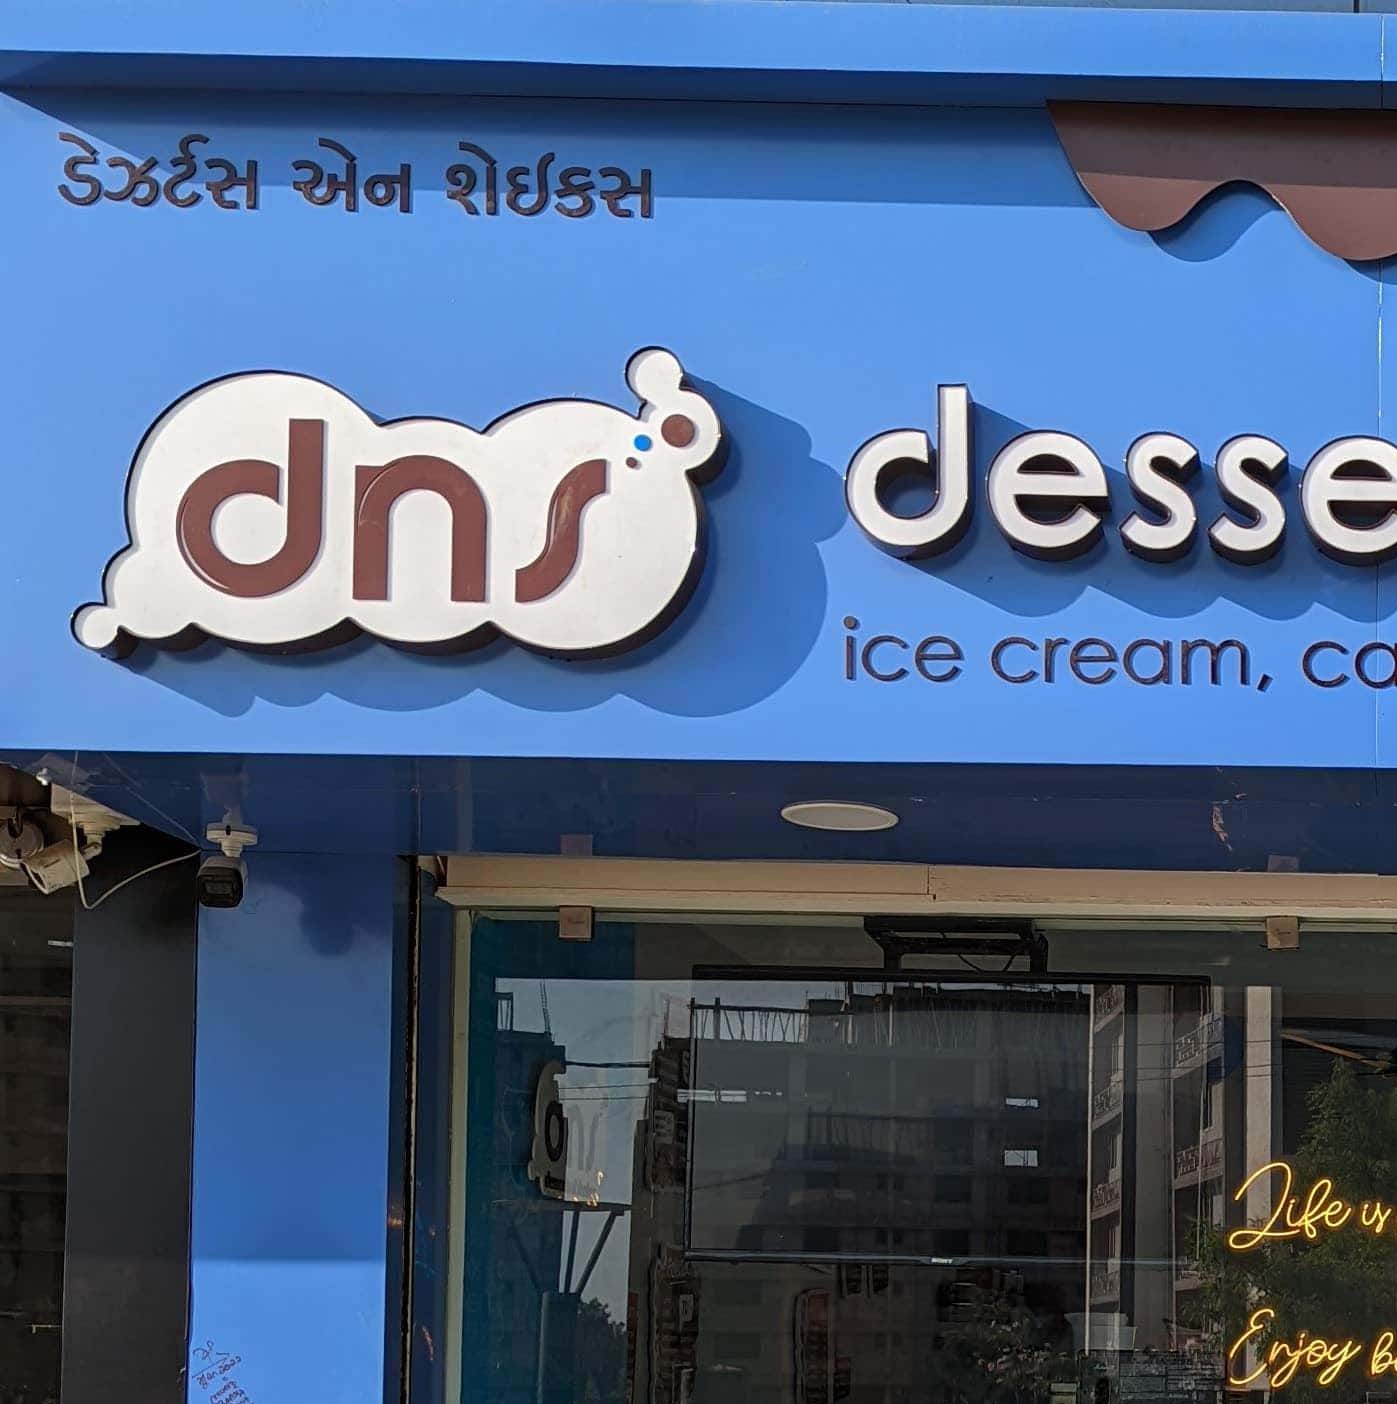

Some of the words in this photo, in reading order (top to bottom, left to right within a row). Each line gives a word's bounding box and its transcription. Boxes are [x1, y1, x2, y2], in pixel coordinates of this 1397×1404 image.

[292, 137, 413, 214] એન
[176, 418, 608, 603] dns
[845, 617, 964, 684] ice
[989, 636, 1274, 692] cream,
[1228, 1161, 1352, 1250] Life
[1361, 1203, 1391, 1237] is
[1229, 1308, 1362, 1389] Enjoy
